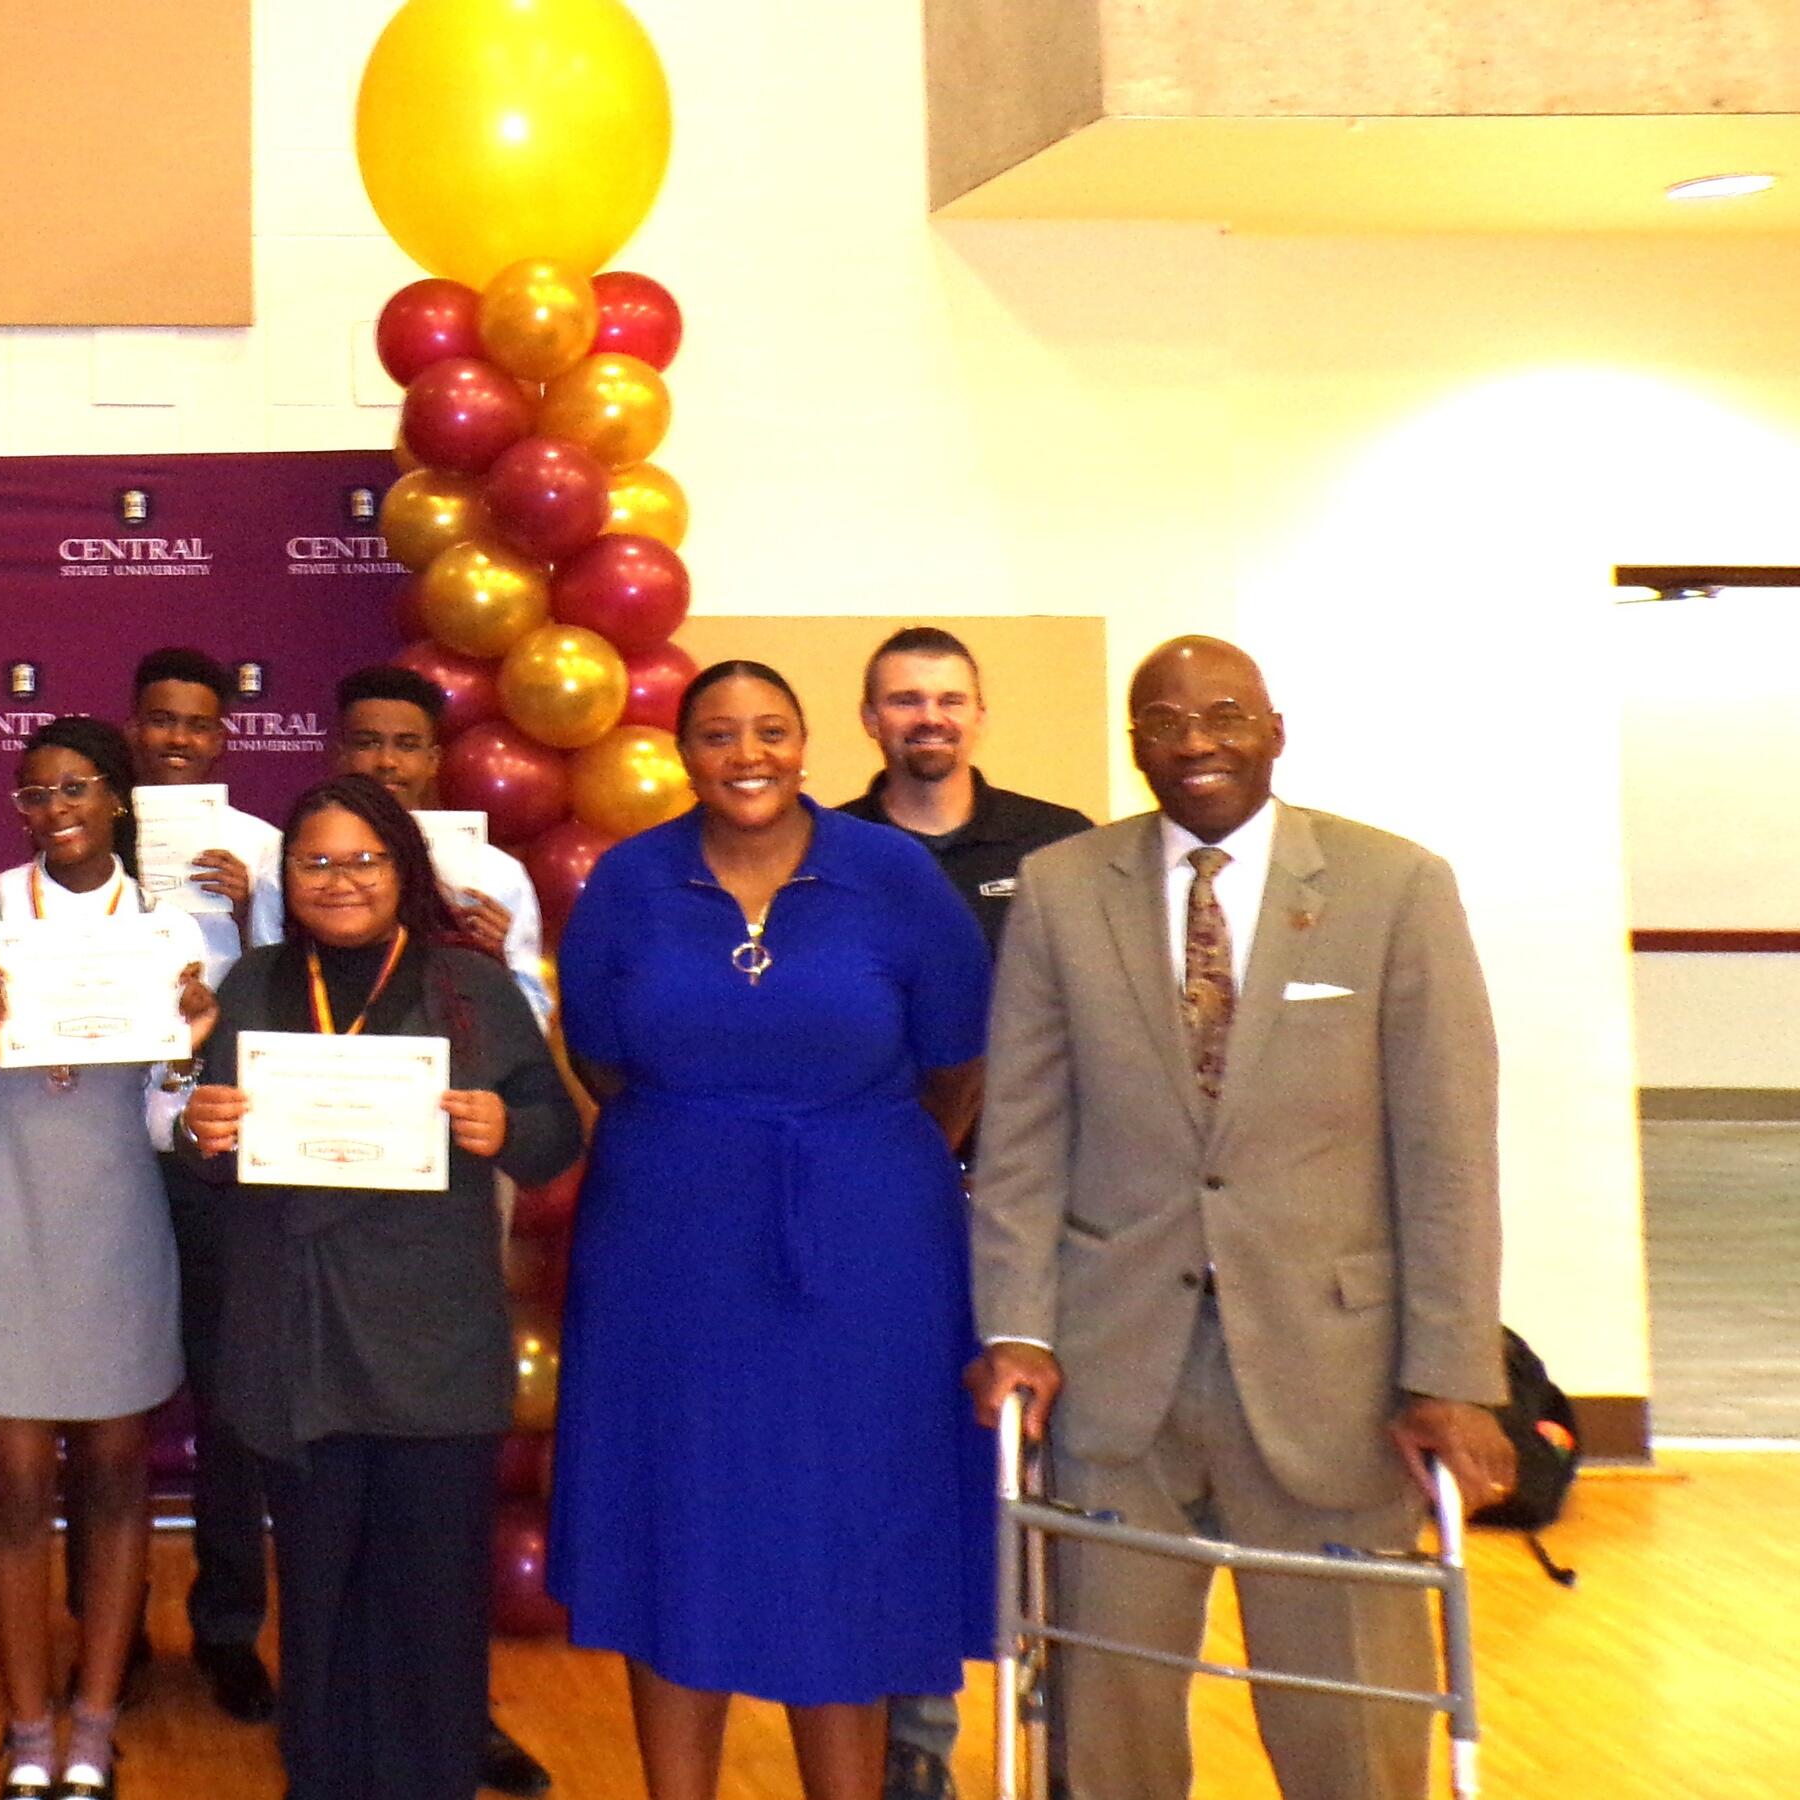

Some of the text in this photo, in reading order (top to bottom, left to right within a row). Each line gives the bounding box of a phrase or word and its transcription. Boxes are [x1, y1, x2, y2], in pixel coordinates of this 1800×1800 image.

[59, 538, 213, 561] CENTRAL
[286, 537, 388, 558] CENT
[60, 564, 210, 576] STATE UNIVERSITY
[287, 563, 413, 574] STATE UNIVER
[220, 713, 327, 735] NTRAL
